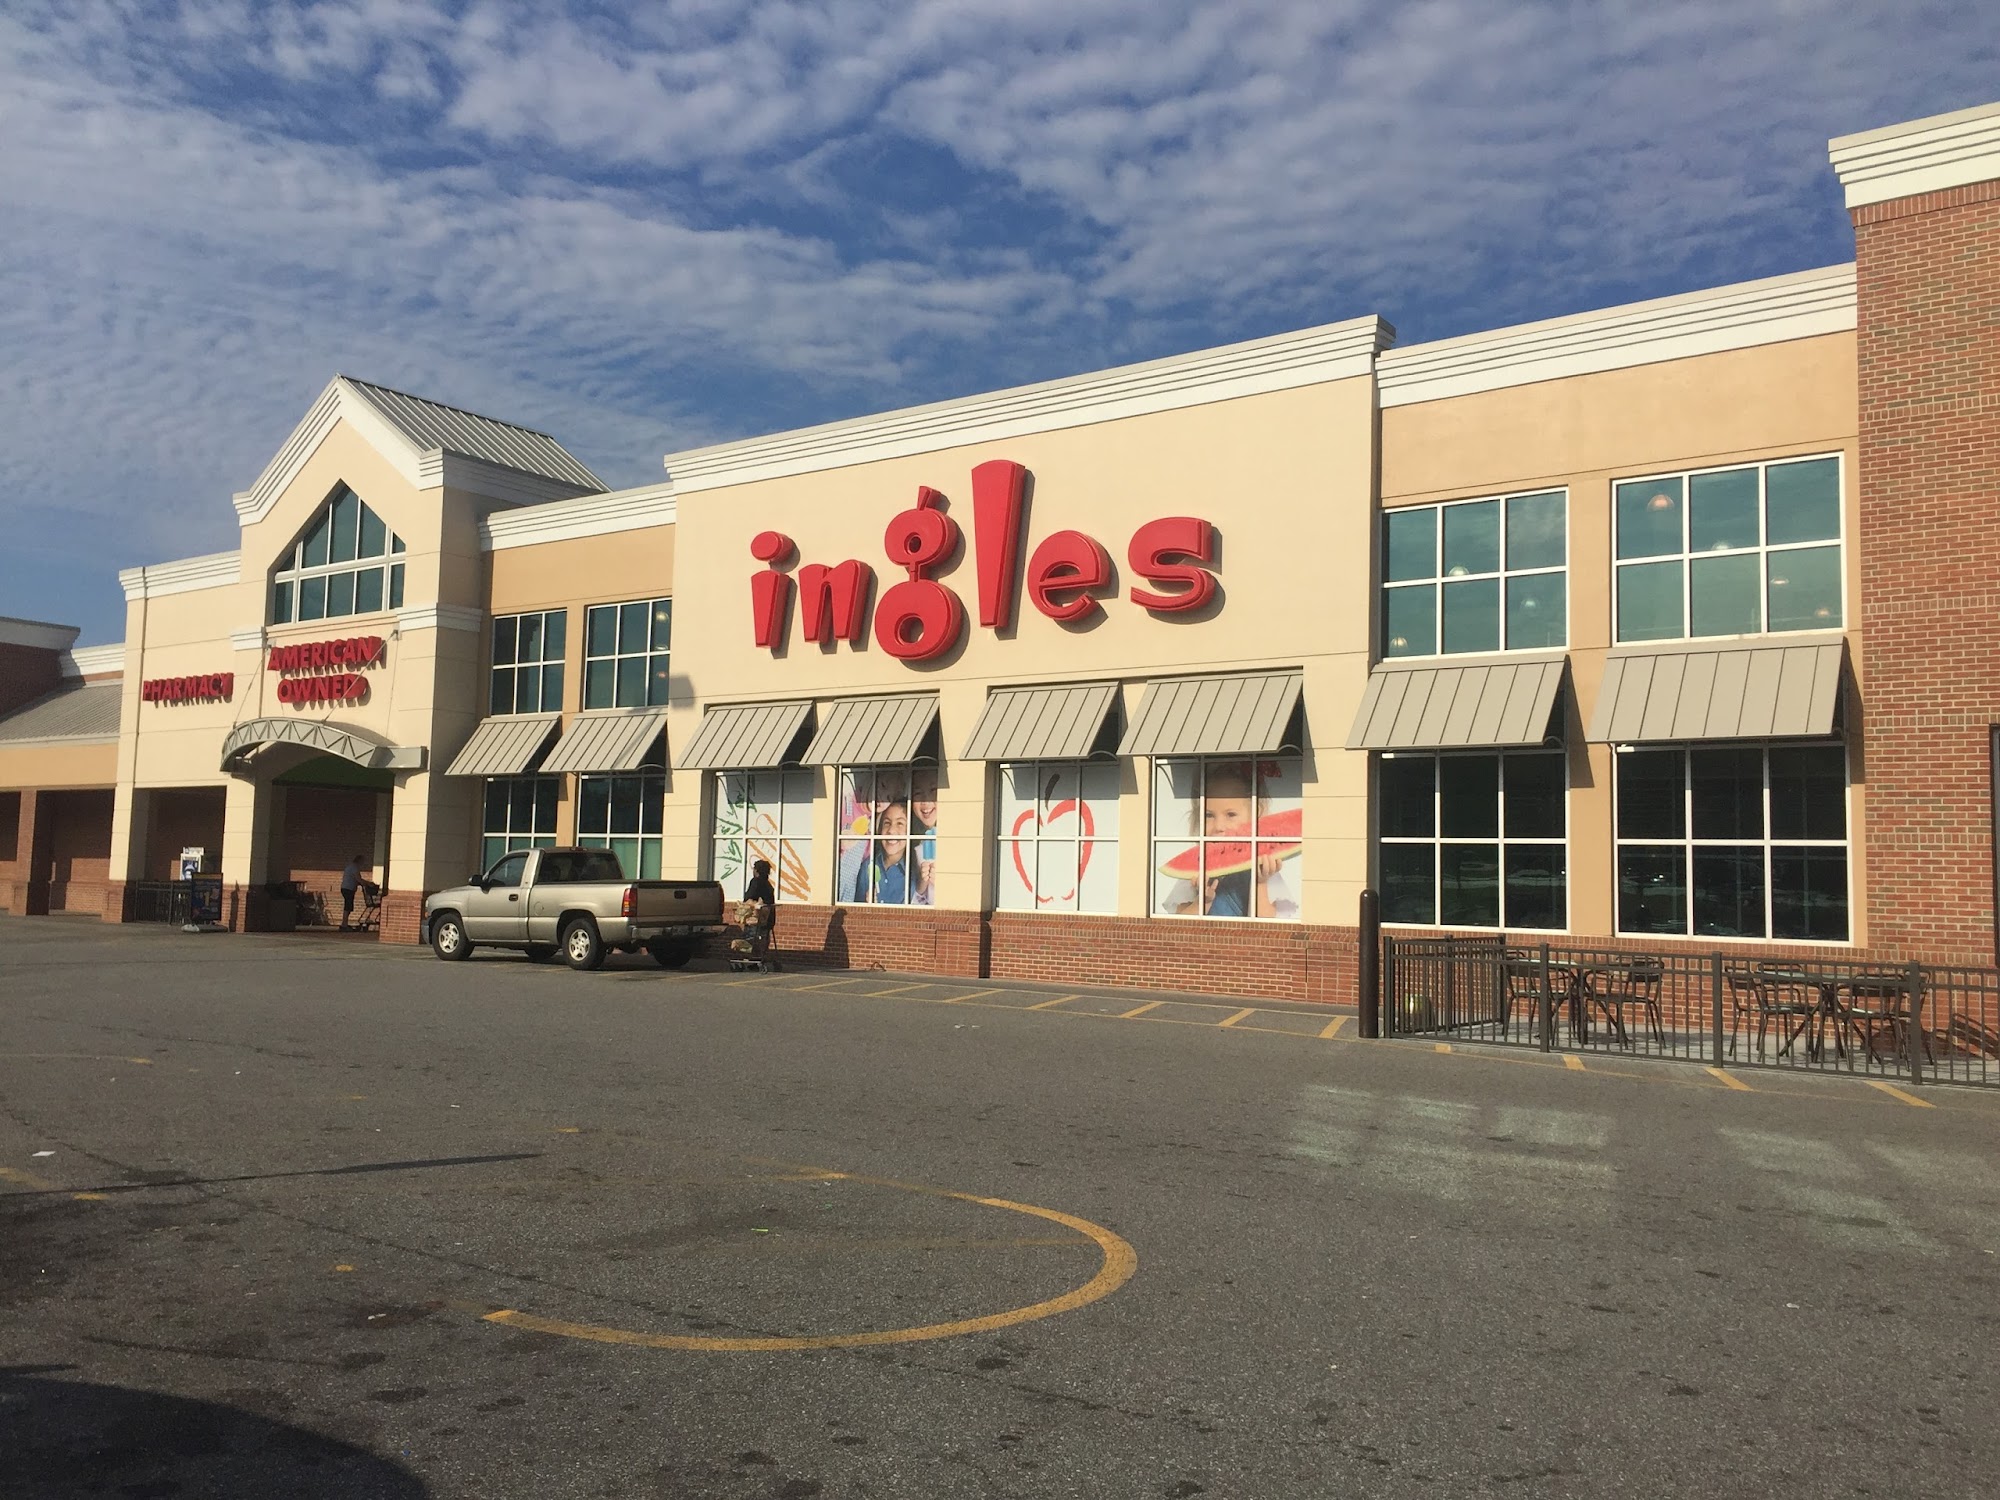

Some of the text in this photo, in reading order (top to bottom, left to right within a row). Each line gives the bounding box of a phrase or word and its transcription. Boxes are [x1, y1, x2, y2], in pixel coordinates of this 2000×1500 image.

[751, 459, 1215, 660] ingles
[267, 636, 382, 671] AMERICAN
[143, 673, 234, 701] PHARMACY
[277, 673, 369, 703] OWNED
